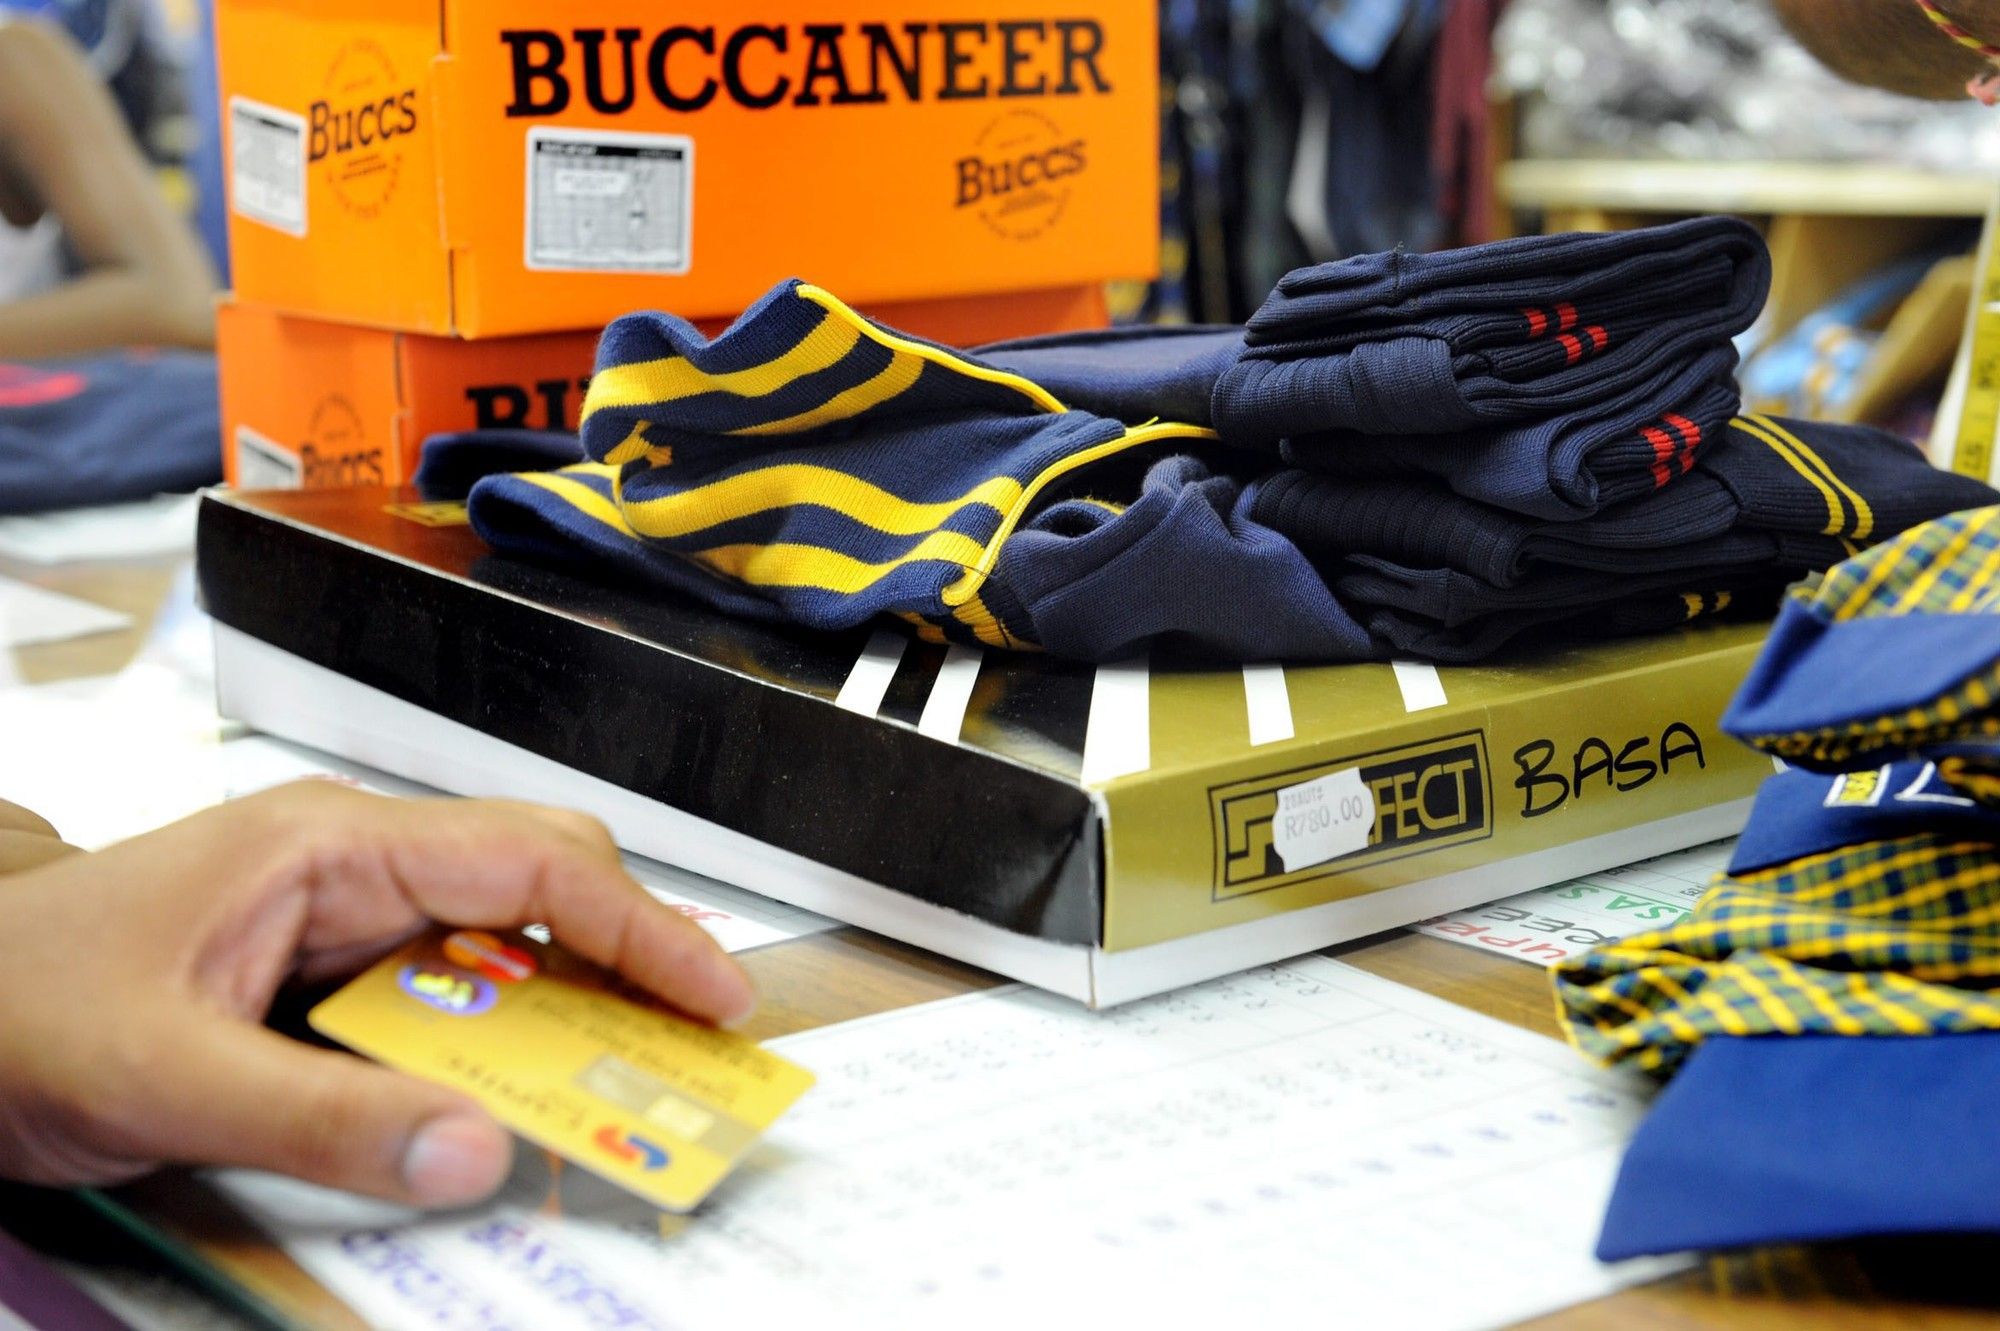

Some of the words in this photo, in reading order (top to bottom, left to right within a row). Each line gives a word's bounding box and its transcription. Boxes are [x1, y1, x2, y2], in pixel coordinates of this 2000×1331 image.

[500, 17, 1113, 118] BUCCANEER
[308, 89, 417, 163] Buccs
[953, 139, 1087, 209] Buccs
[1513, 721, 1707, 819] BASA
[1284, 794, 1364, 841] R780.00
